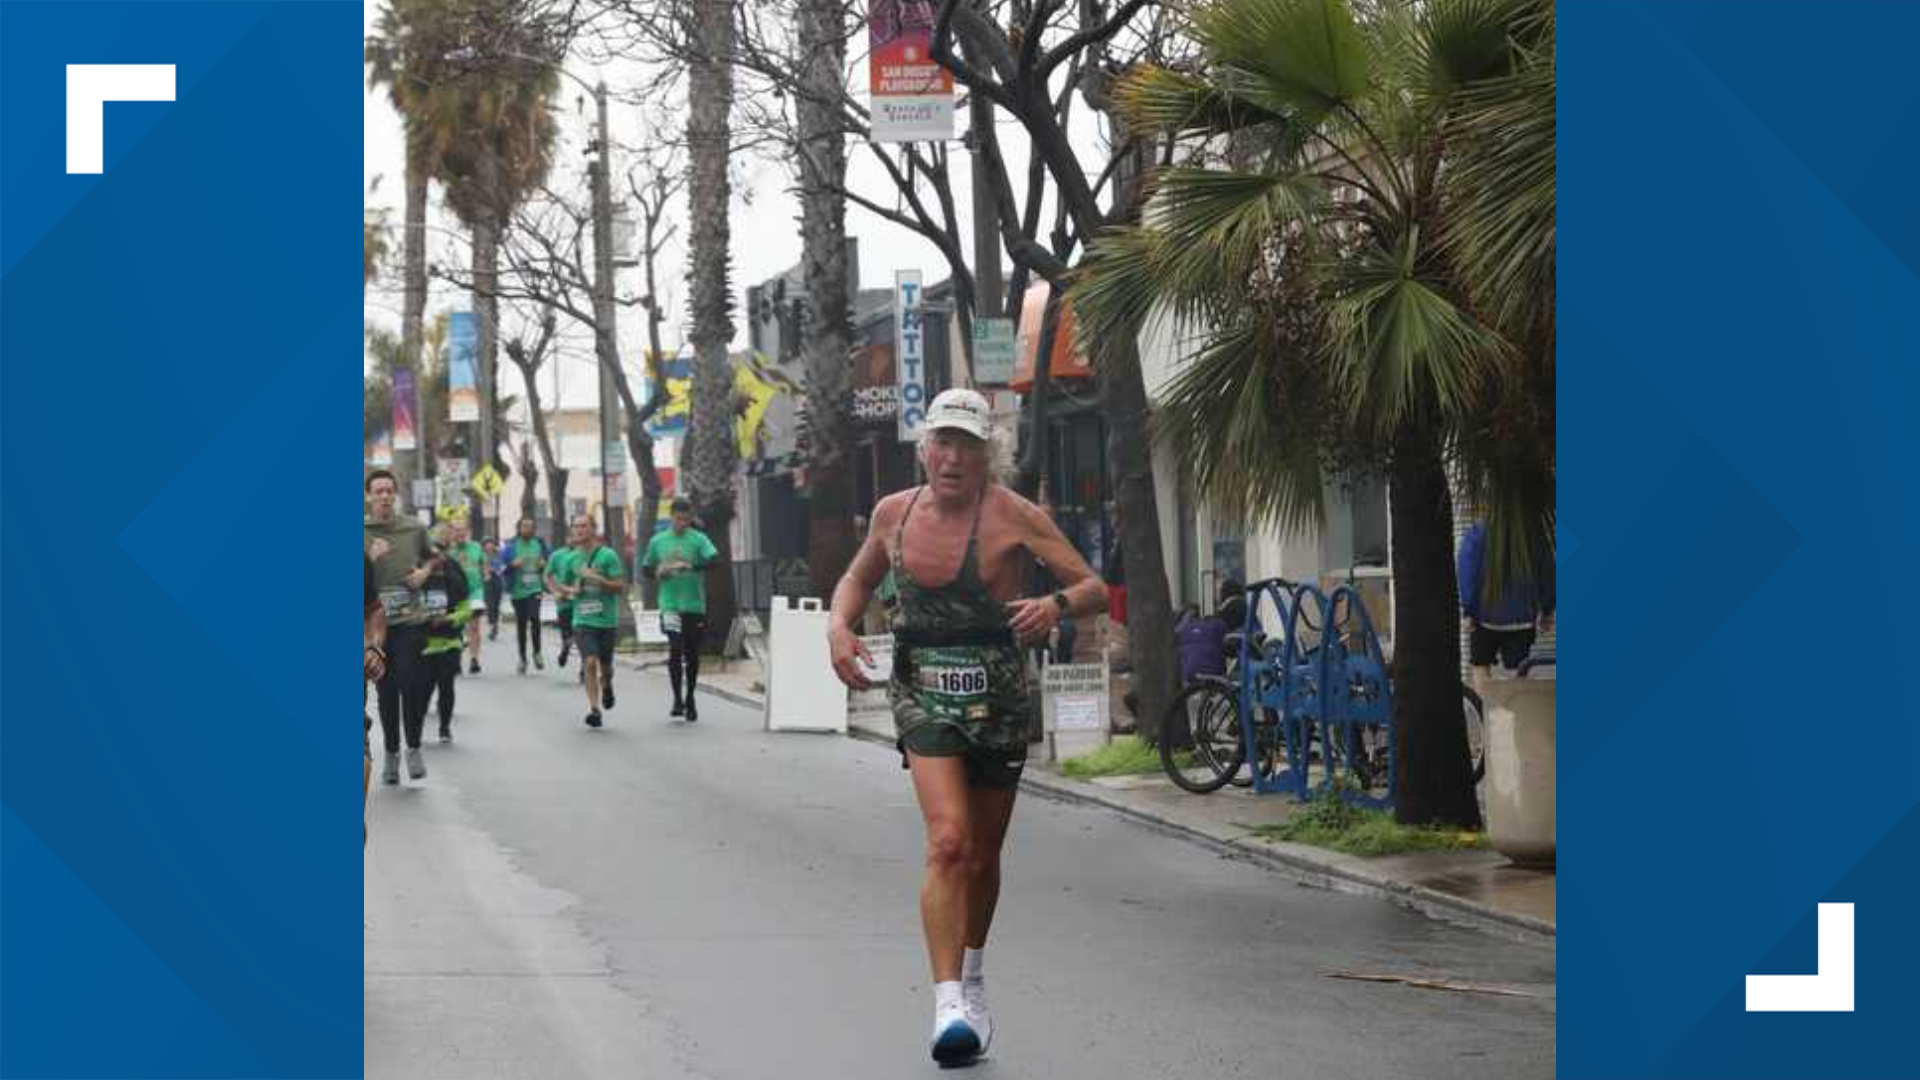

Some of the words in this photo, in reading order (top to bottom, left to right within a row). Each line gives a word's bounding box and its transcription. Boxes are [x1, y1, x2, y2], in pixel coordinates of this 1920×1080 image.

[881, 65, 901, 78] SAN
[902, 282, 924, 429] TATTOO
[940, 672, 986, 692] 1606
